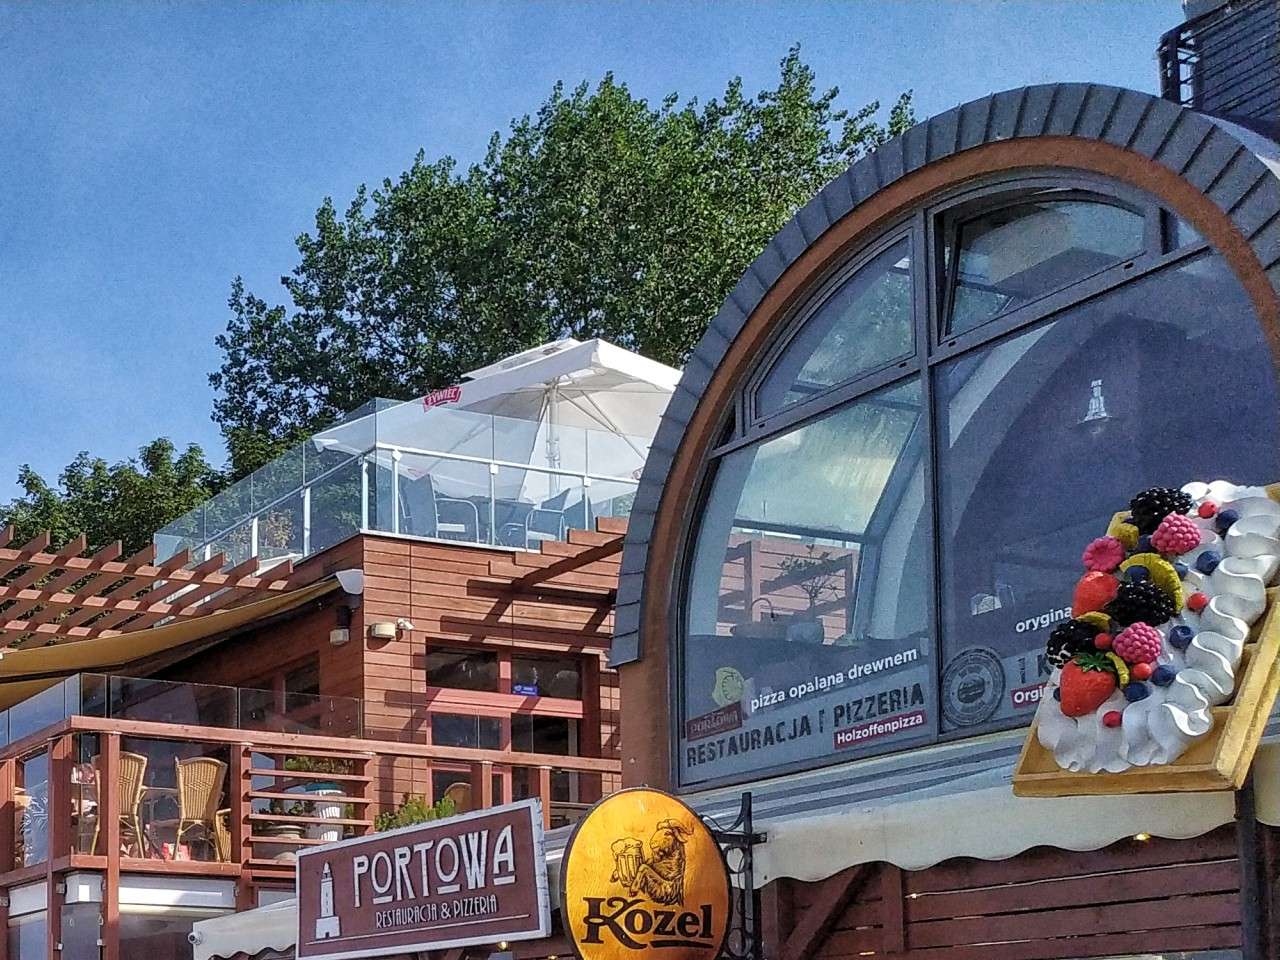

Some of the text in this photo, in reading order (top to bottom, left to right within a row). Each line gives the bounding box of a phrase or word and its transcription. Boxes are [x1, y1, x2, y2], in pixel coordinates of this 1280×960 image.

[1015, 606, 1073, 633] orygina
[750, 648, 918, 713] pizza opalana drewnem
[1013, 685, 1043, 704] Orgi
[687, 713, 812, 768] RESTAURACJA
[833, 682, 925, 728] PIZZERIA
[837, 714, 924, 745] Holzoffenpizza
[353, 824, 516, 908] PORTOWA
[376, 894, 498, 929] RESTAURACJA & PIZZERIA
[580, 896, 714, 950] Kozel
